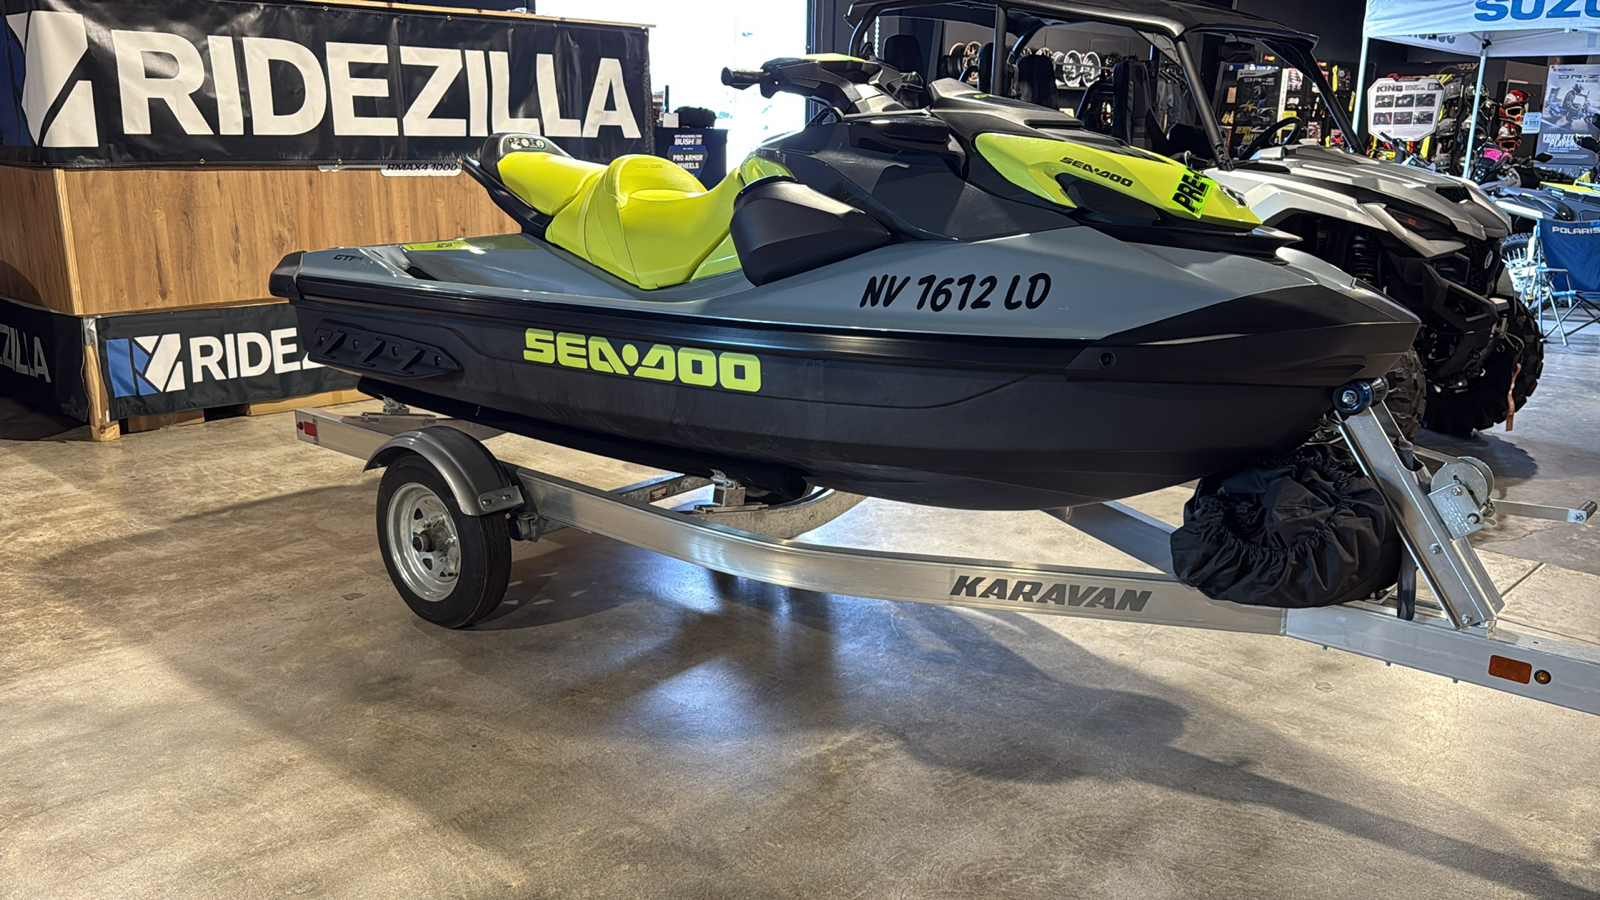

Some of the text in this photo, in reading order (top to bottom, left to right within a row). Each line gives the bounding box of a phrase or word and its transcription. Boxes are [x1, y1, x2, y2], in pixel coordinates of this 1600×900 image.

[111, 29, 641, 138] RIDEZILLA
[432, 163, 458, 171] 1000
[1172, 168, 1211, 214] PRE-
[1552, 226, 1600, 234] POLARIS
[860, 274, 911, 308] NV
[1004, 272, 1051, 310] LD
[0, 324, 51, 383] ZILLA
[950, 575, 1152, 612] KARAVAN
